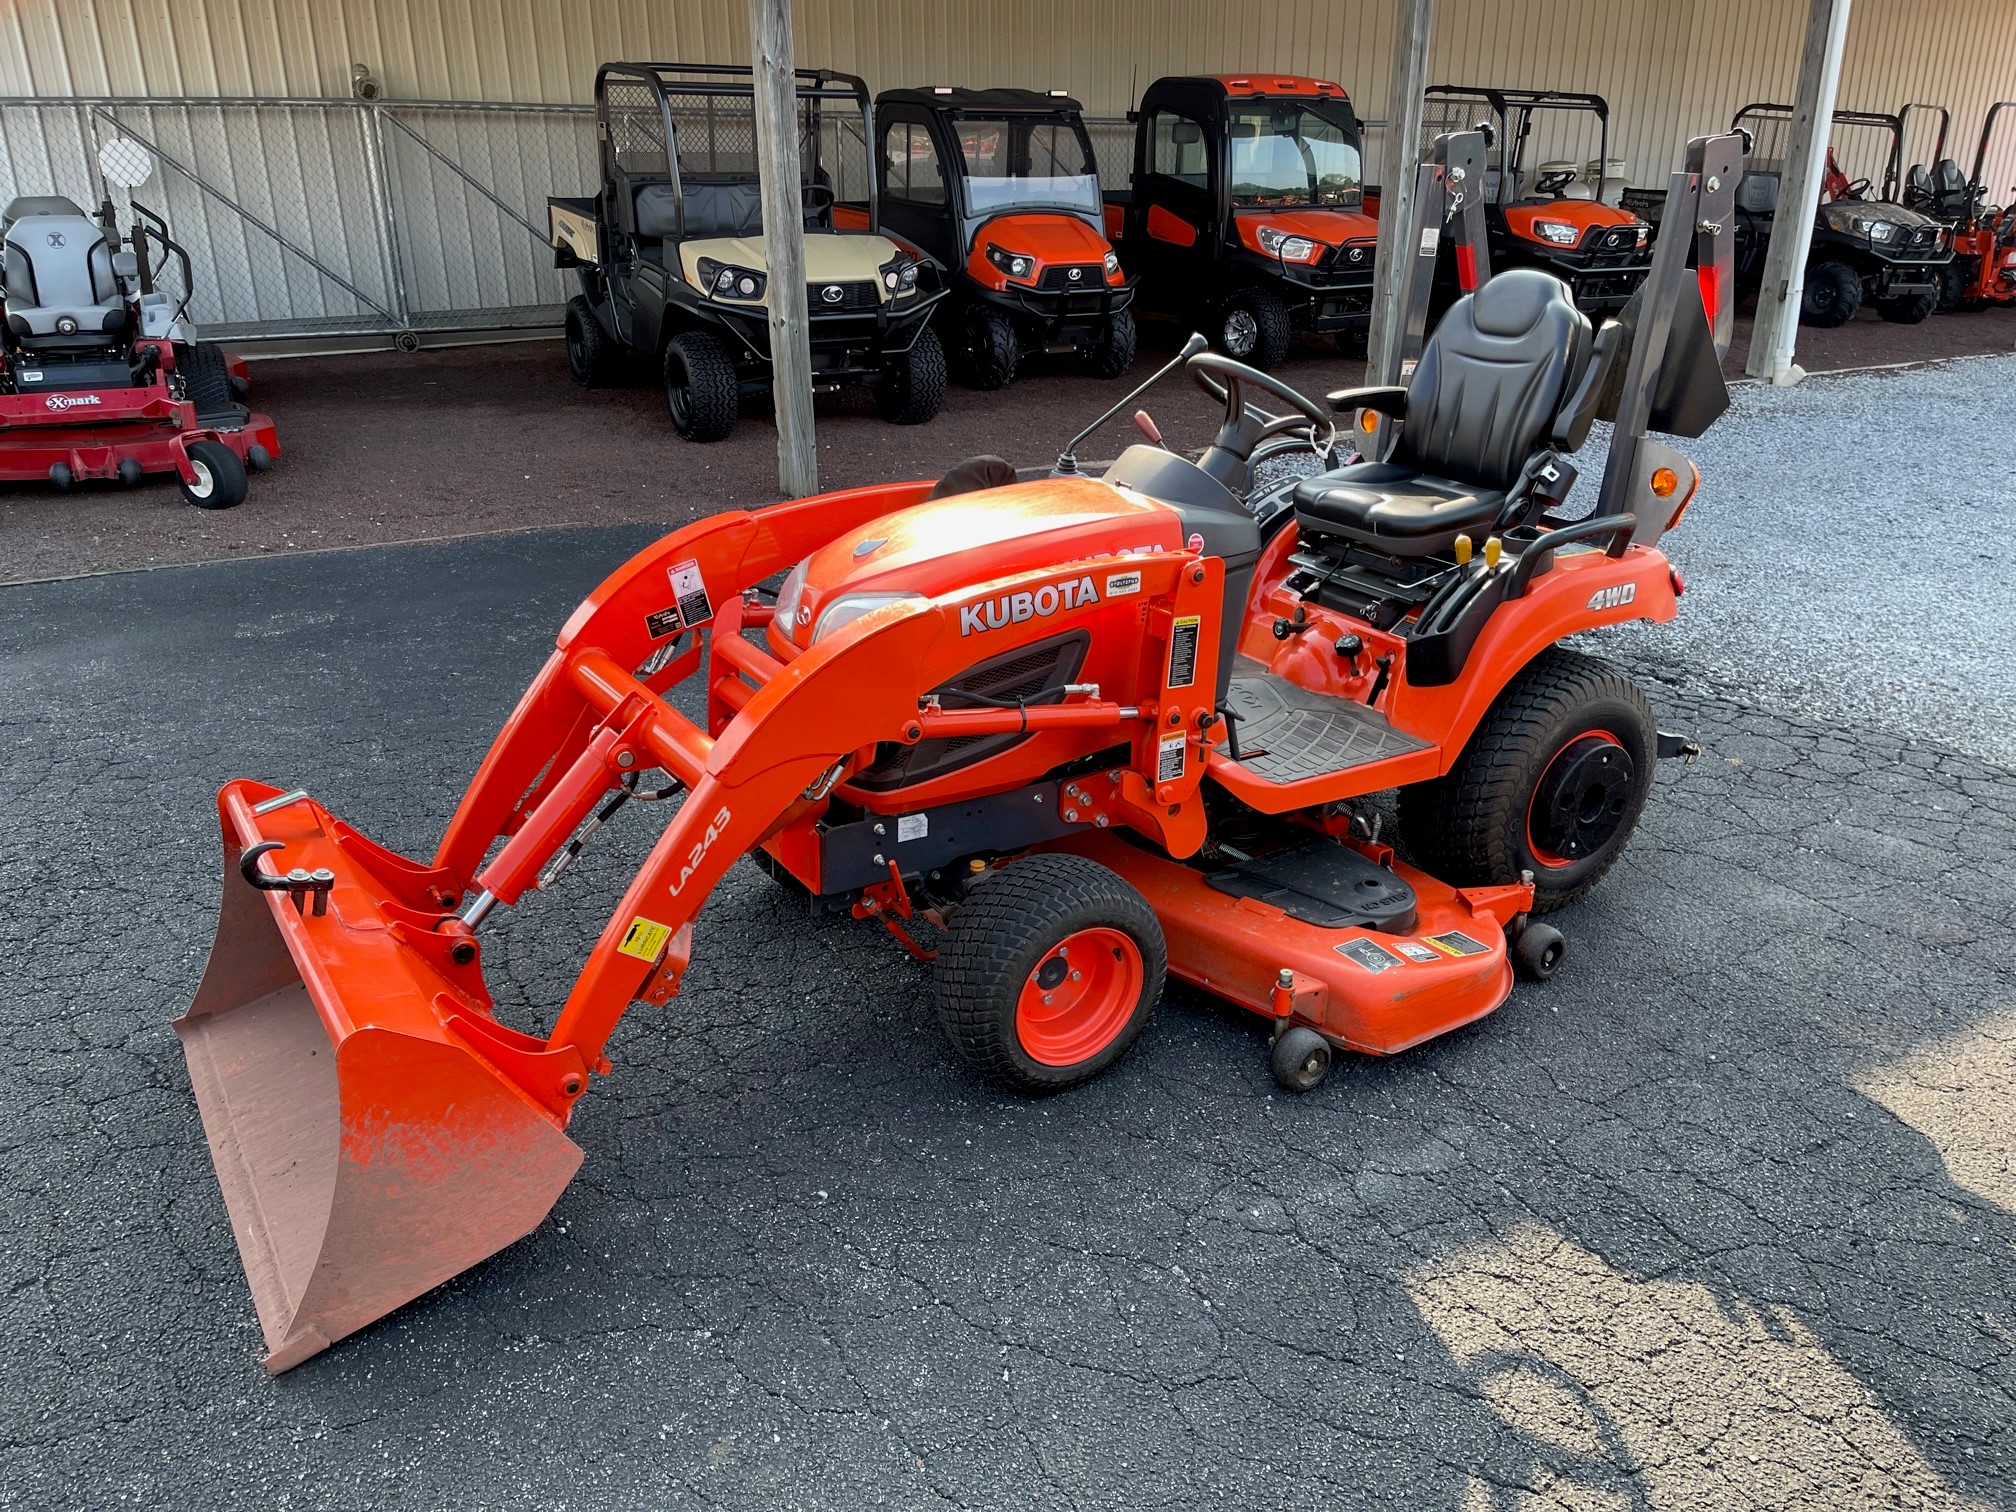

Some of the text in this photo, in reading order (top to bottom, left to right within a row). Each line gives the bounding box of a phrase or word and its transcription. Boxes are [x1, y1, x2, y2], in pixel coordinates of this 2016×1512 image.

[960, 575, 1099, 637] KUBOTA
[1586, 582, 1636, 611] 4WD
[669, 806, 731, 896] LA243
